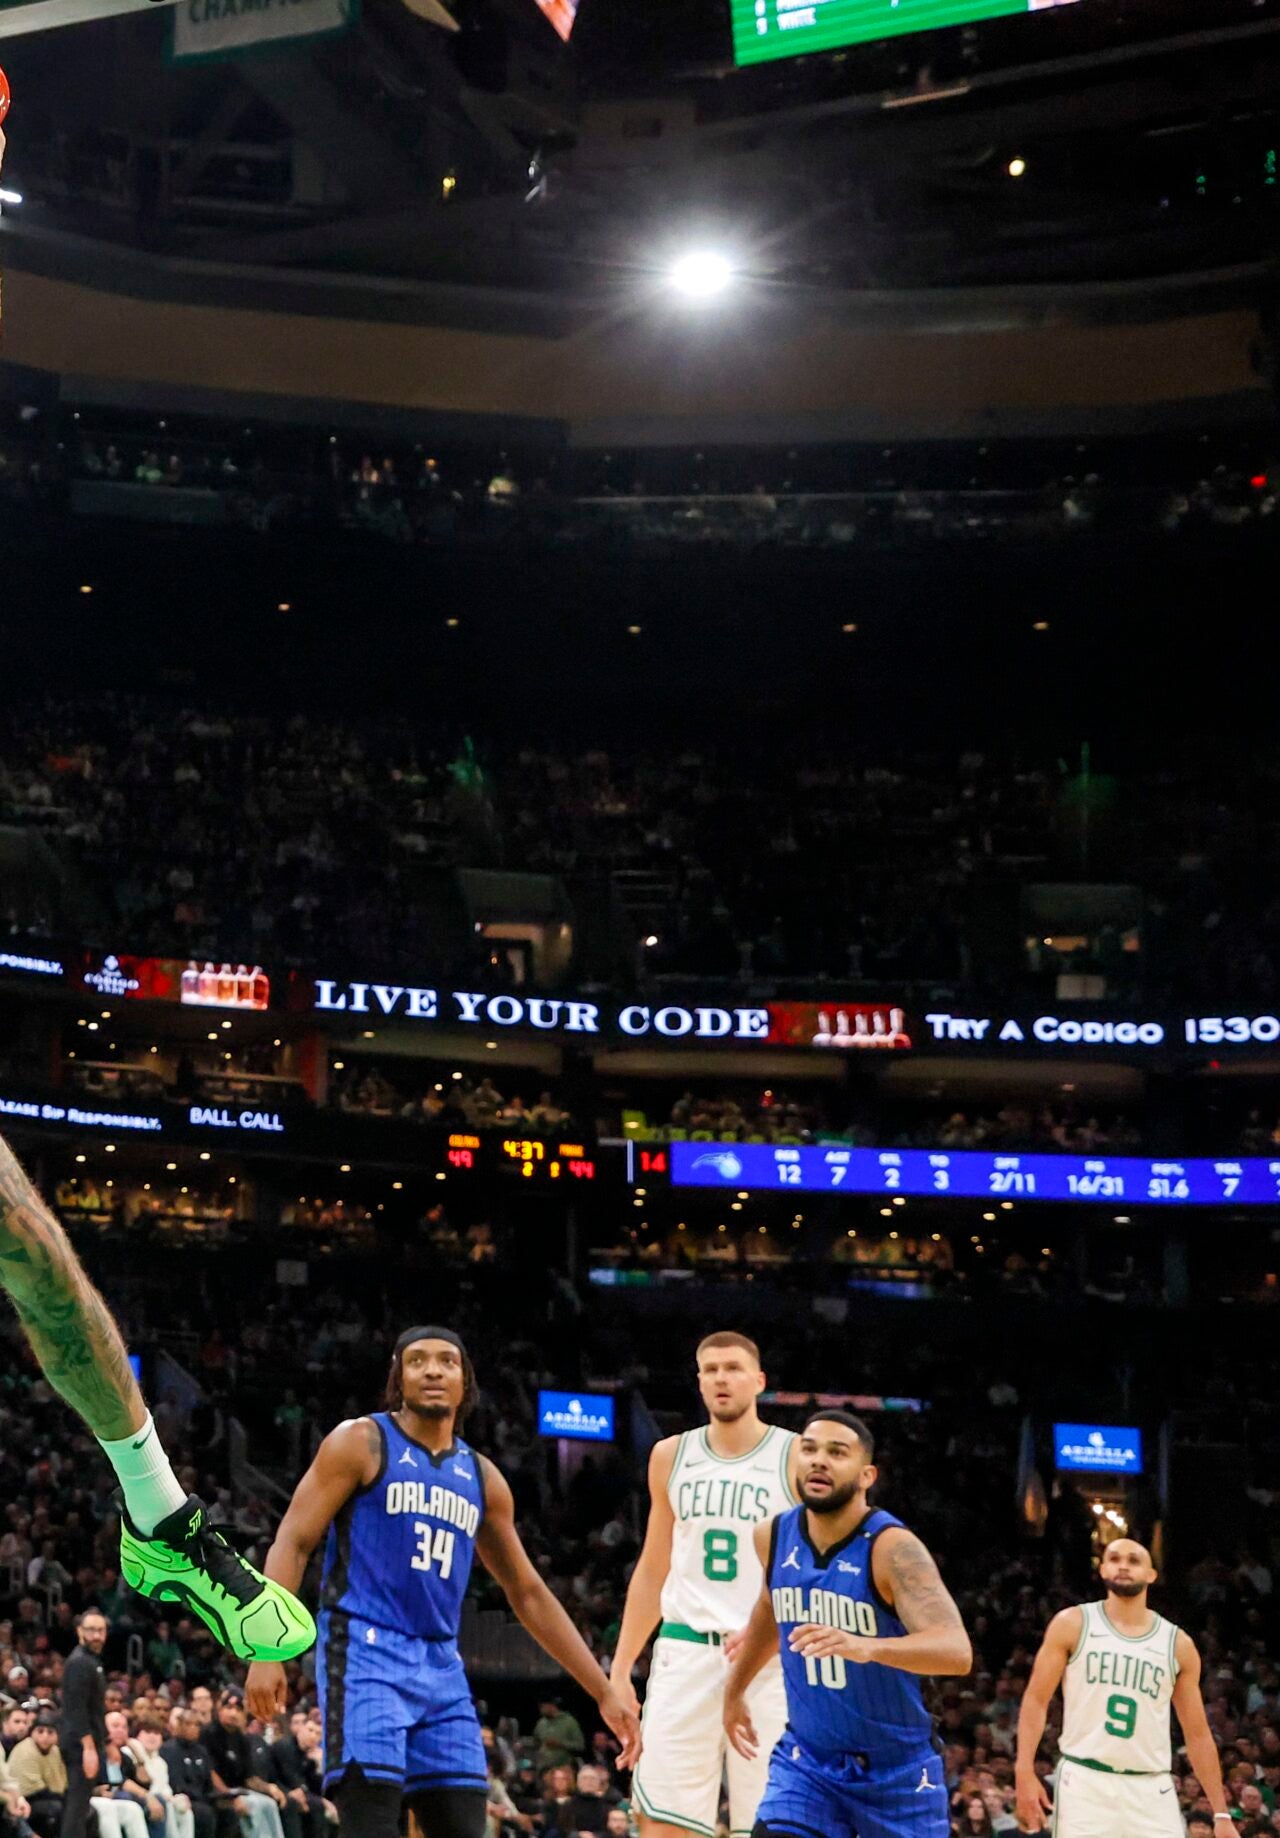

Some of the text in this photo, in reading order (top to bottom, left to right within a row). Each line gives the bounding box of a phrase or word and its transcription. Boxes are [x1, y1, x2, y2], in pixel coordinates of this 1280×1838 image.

[314, 980, 769, 1039] LIVE YOUR CODE
[925, 1014, 1280, 1044] TRY A CODIGO 1530
[41, 1104, 65, 1120] SIP
[239, 1111, 284, 1131] CALL
[448, 1150, 473, 1168] 49
[640, 1151, 666, 1172] 14
[777, 1164, 802, 1184] 12
[830, 1166, 847, 1186] 7
[884, 1167, 900, 1188] 2
[934, 1169, 950, 1190] 3
[989, 1171, 1036, 1193] 2/11
[1067, 1174, 1124, 1196] 16/31
[1222, 1177, 1240, 1198] 7
[385, 1480, 480, 1538] ORLANDO
[679, 1479, 769, 1523] CELTICS
[410, 1521, 455, 1580] 34
[703, 1528, 738, 1582] 8
[772, 1586, 878, 1637] ORLANDO
[805, 1654, 848, 1690] 10
[1086, 1651, 1166, 1700] CELTICS
[1105, 1693, 1138, 1739] 9
